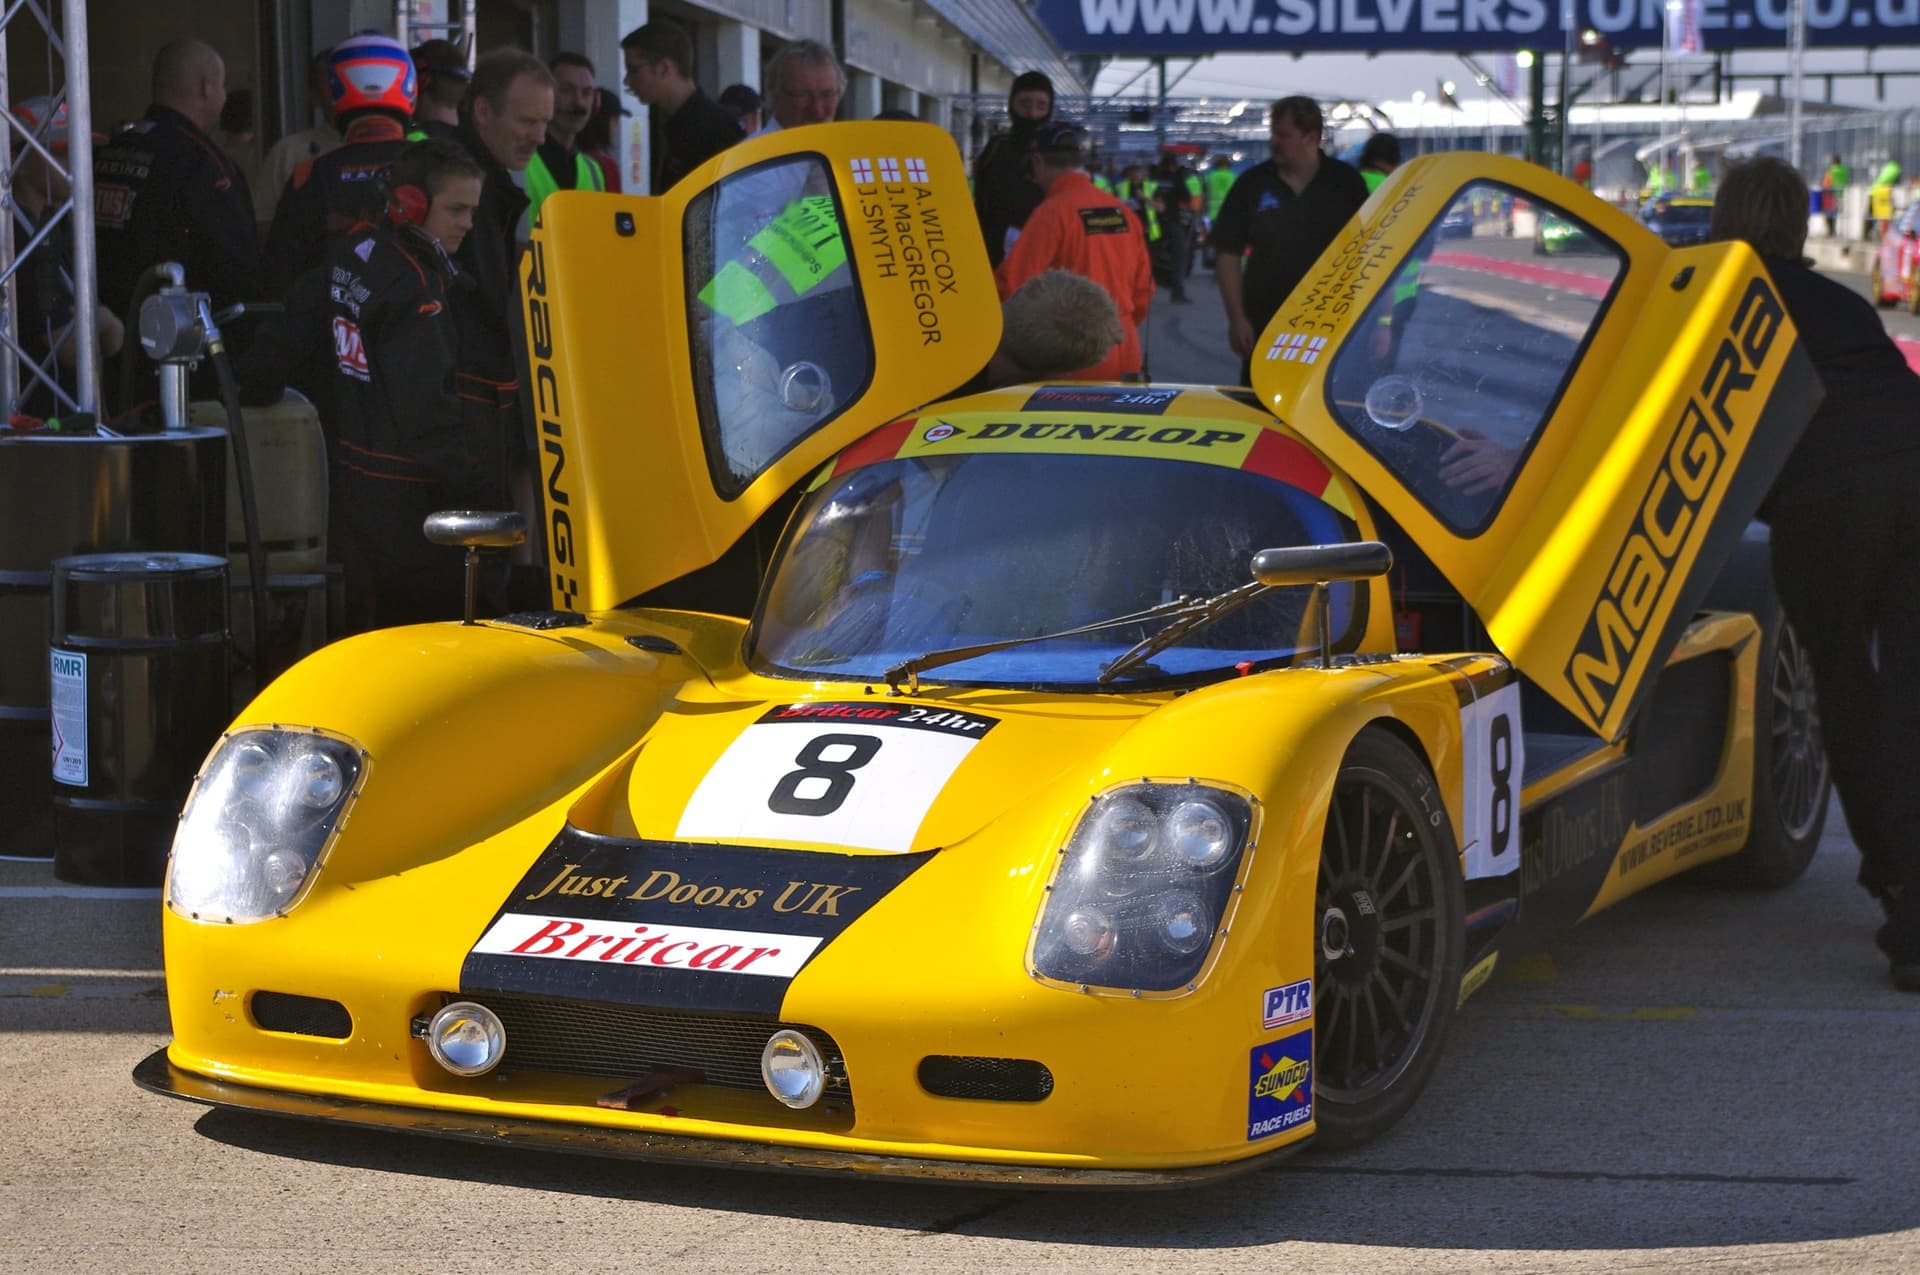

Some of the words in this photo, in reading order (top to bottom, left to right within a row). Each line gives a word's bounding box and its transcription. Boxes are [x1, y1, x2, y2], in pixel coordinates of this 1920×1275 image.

[858, 188, 898, 278] J.SMYTH
[914, 186, 958, 314] A.WILCOX
[886, 186, 942, 346] J.MacGREGOR
[1319, 245, 1393, 333] J.SMYTH
[1112, 393, 1163, 406] 24hr
[967, 422, 1245, 448] DUNLOP
[53, 657, 82, 677] RMR
[775, 703, 900, 720] Britcar
[897, 707, 987, 732] 24hr
[767, 733, 883, 817] 8
[1490, 713, 1512, 857] 8
[526, 863, 629, 901] Just
[626, 870, 765, 910] Doors
[772, 881, 862, 917] UK
[504, 919, 781, 972] Britcar
[1266, 981, 1311, 1019] PTR
[1257, 1062, 1308, 1095] SUNOCO
[1250, 1114, 1284, 1137] RACE
[1283, 1104, 1312, 1127] FUELS
